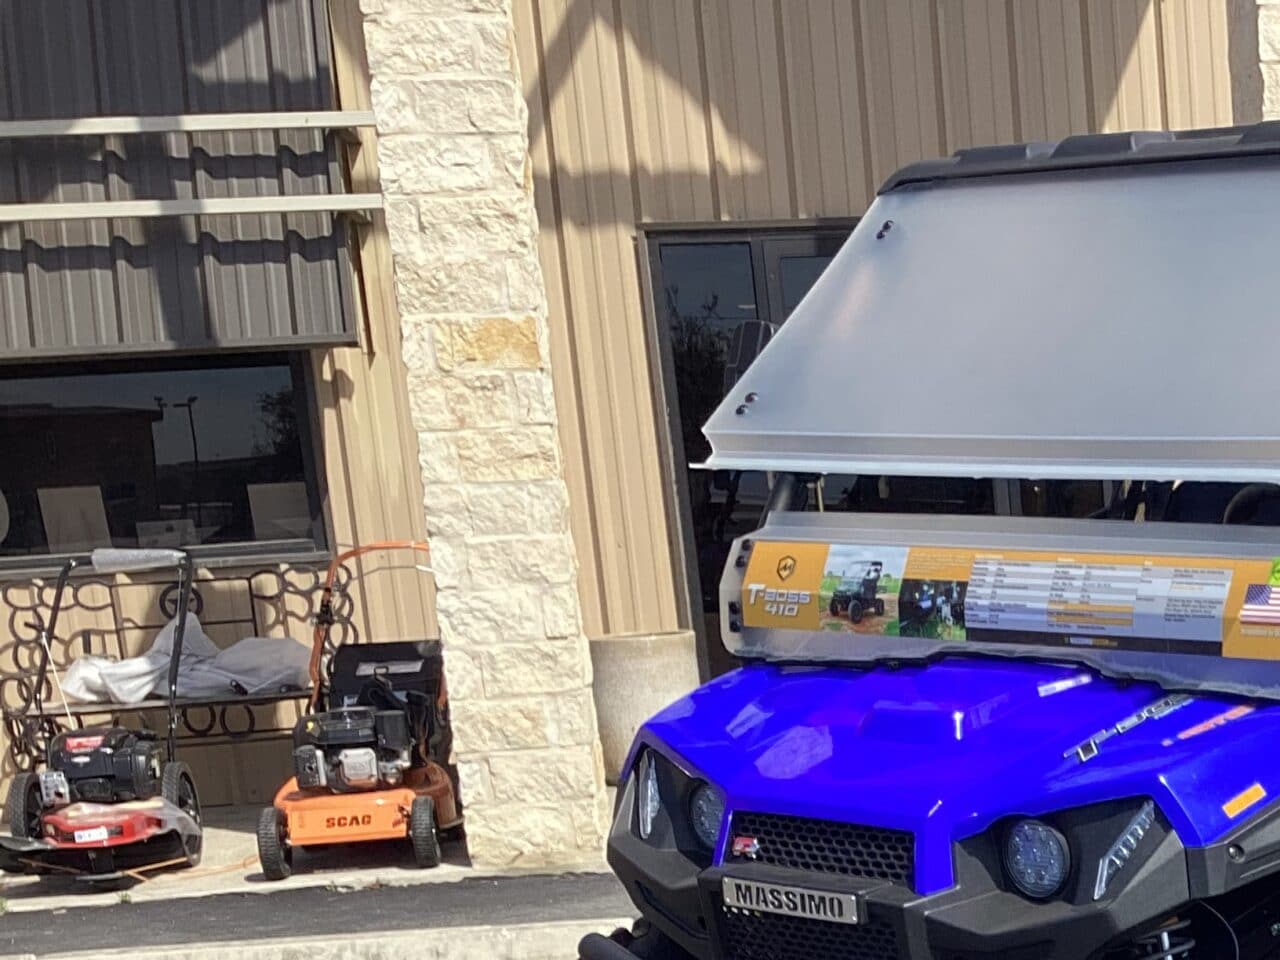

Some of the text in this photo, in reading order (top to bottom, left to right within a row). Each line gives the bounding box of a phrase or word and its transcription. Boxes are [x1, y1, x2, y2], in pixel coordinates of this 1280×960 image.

[748, 584, 810, 605] T-BOSS
[765, 603, 798, 616] 410
[326, 815, 372, 829] SCAG
[734, 883, 844, 918] MASSIMO
